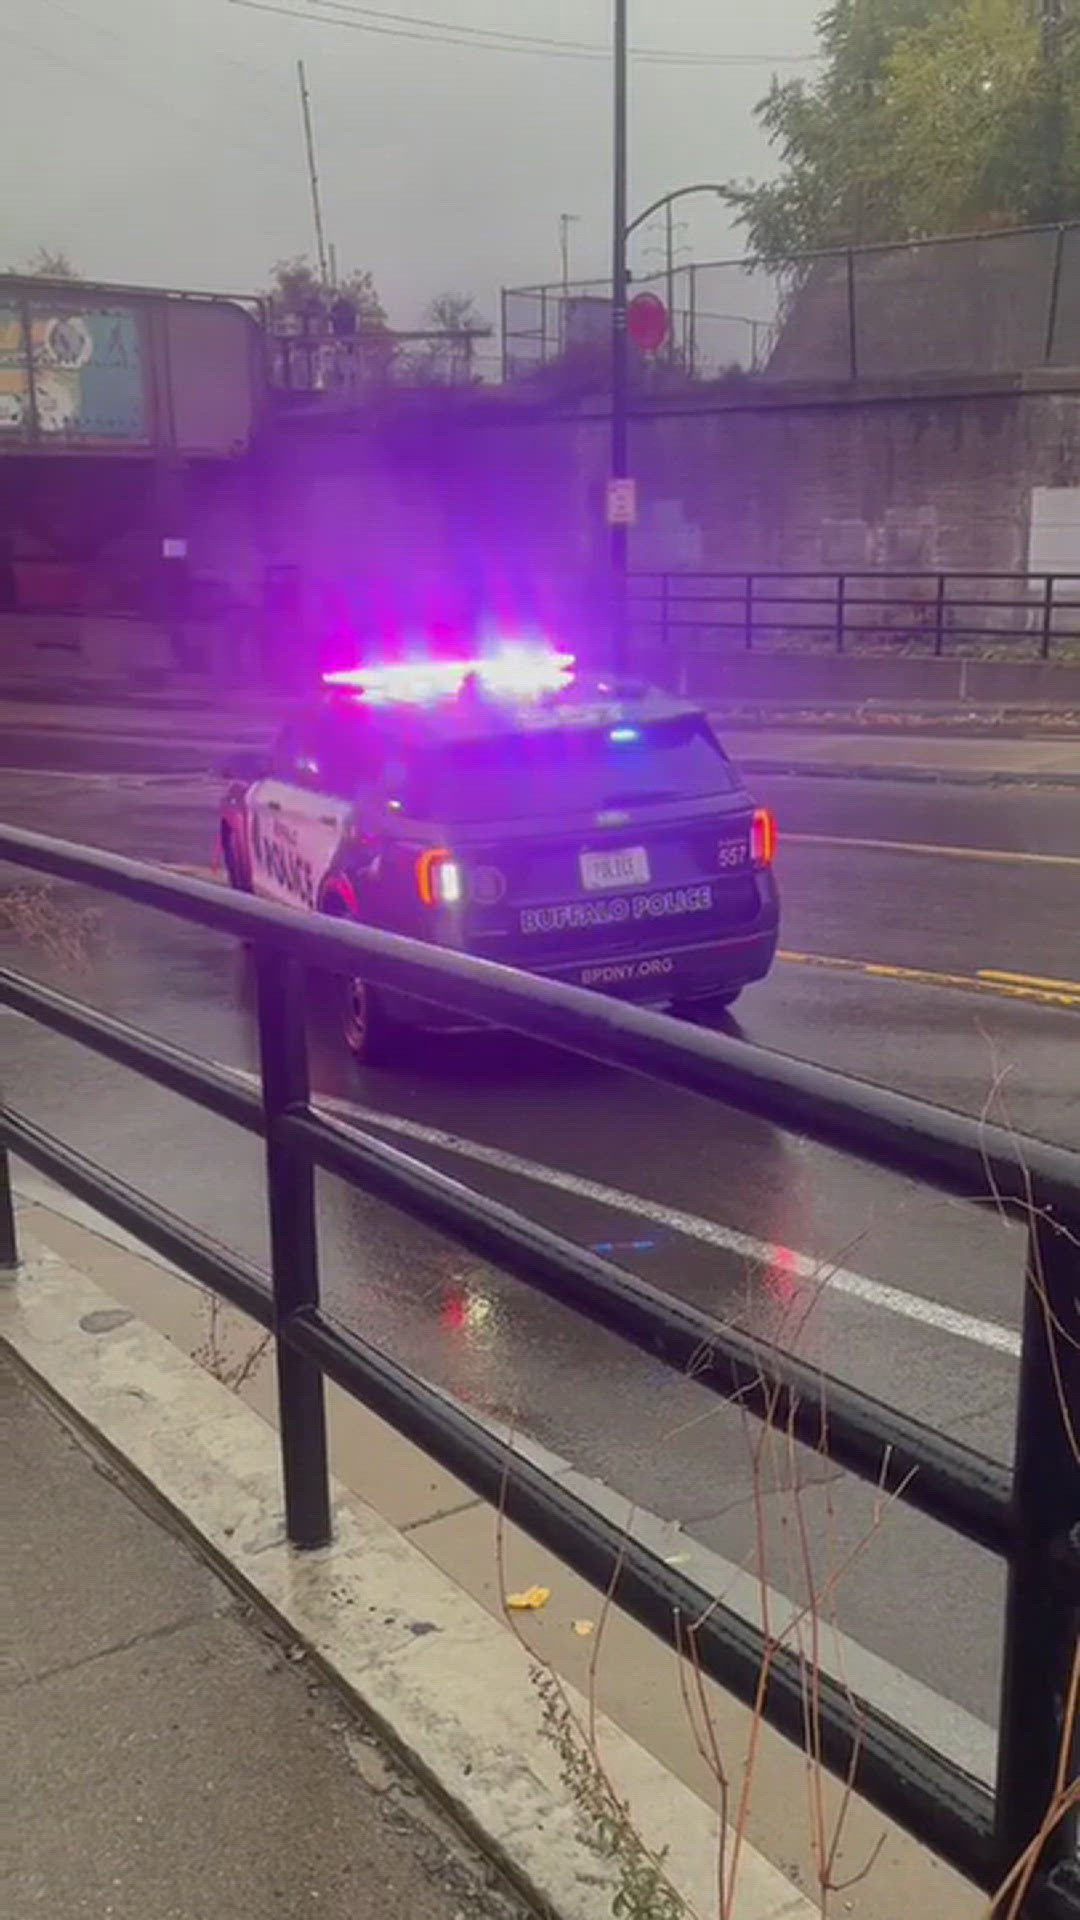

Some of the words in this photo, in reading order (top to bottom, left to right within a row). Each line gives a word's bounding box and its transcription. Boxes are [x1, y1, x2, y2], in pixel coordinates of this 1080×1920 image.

[718, 846, 747, 866] 557
[520, 900, 630, 934] BUFFALO
[632, 885, 713, 919] POLICE
[581, 957, 674, 985] BPDNY.ORG
